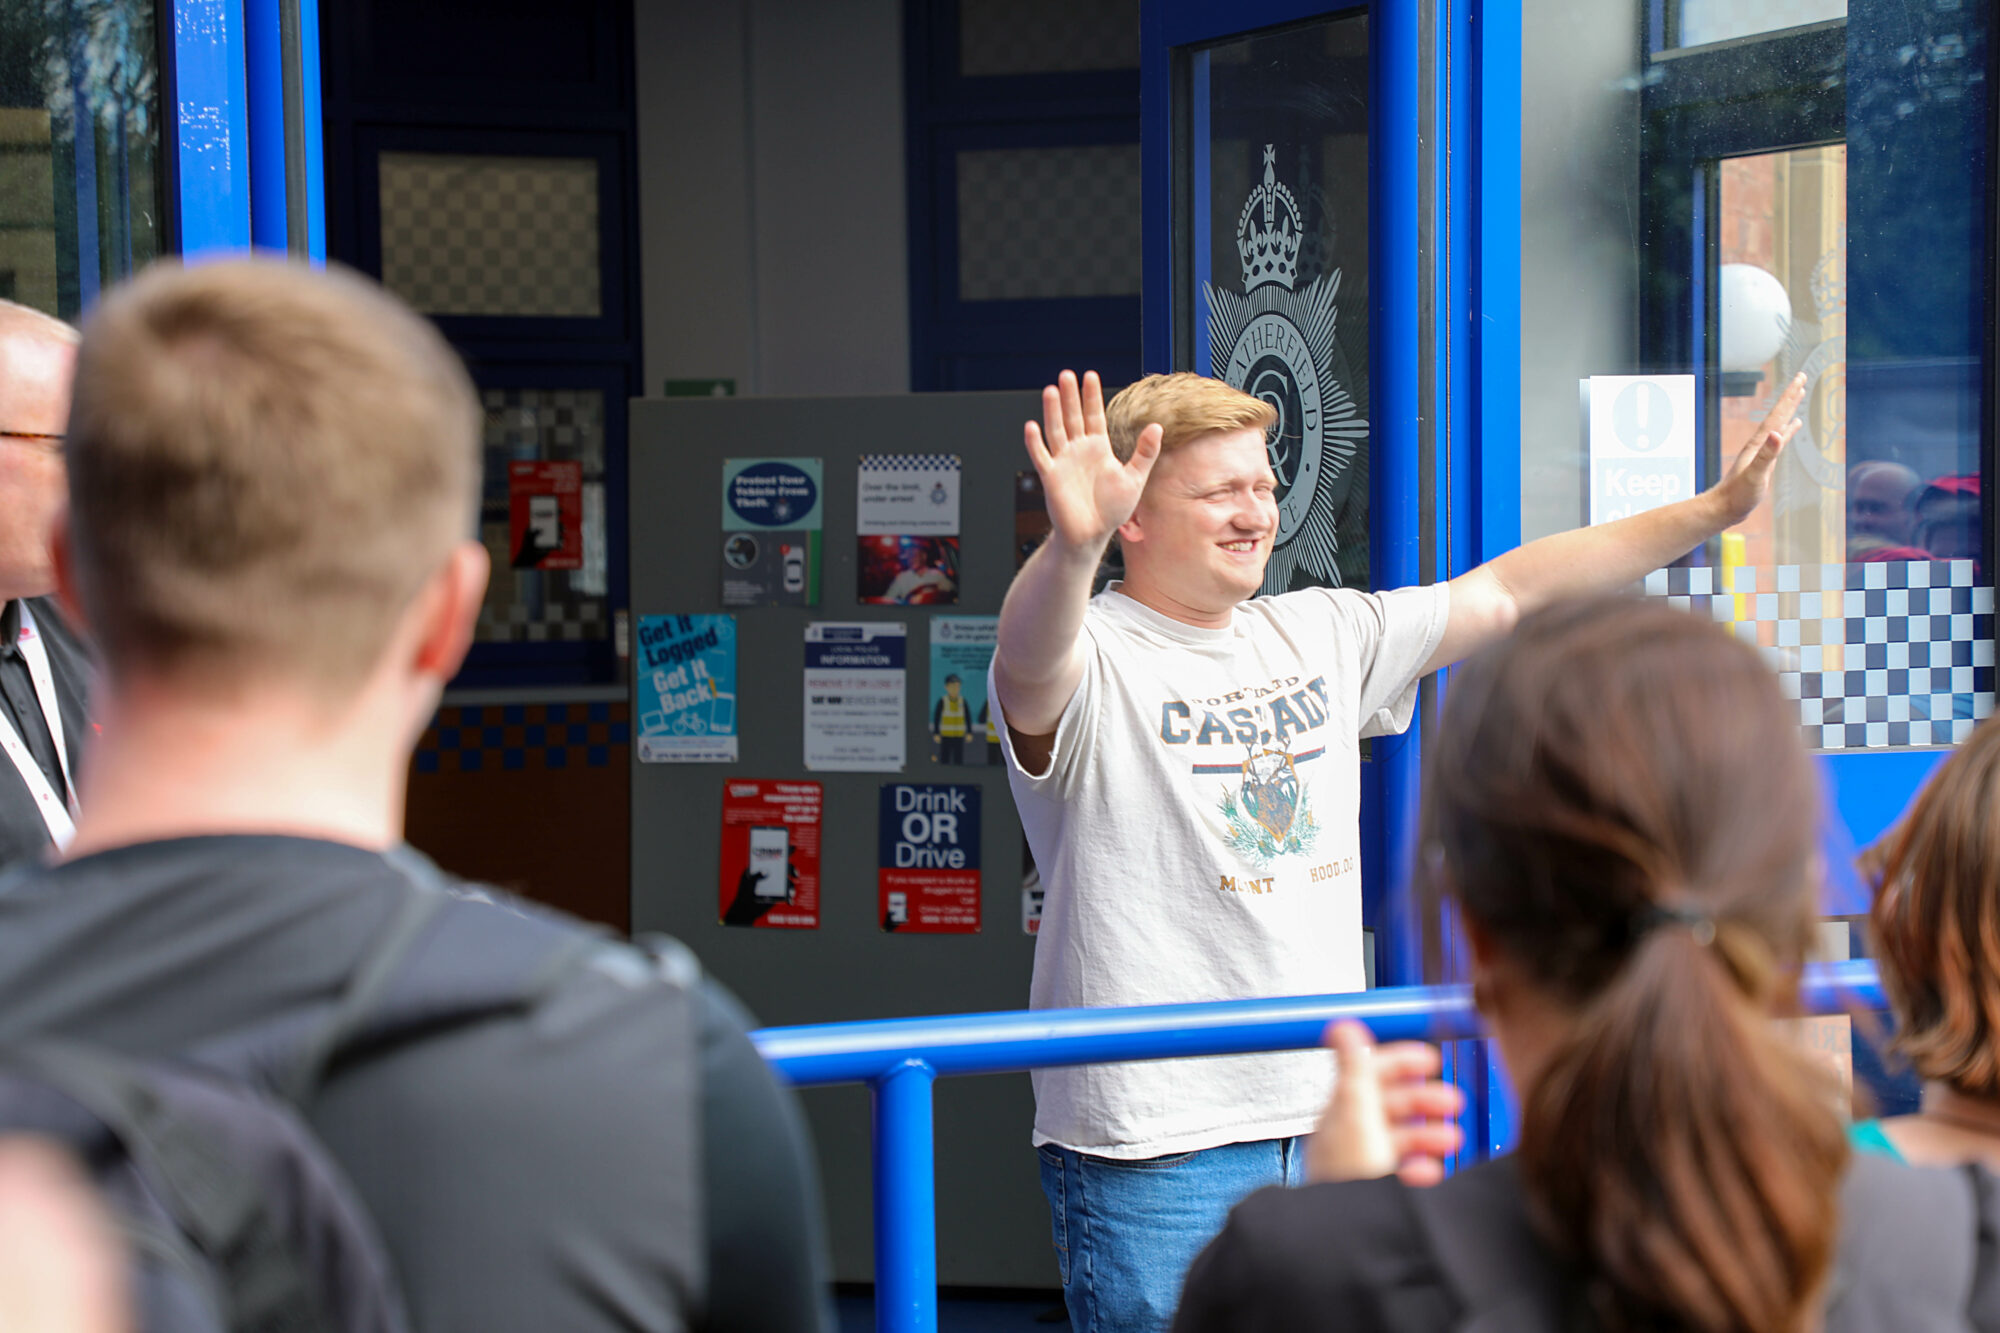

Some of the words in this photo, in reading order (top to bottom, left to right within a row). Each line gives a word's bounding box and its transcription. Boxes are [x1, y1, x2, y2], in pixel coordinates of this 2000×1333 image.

[863, 494, 887, 503] under
[885, 482, 899, 491] the
[1605, 468, 1681, 503] Keep
[639, 620, 673, 647] Get
[645, 626, 718, 667] Logged
[820, 654, 891, 666] INFORMATION
[653, 665, 689, 694] Get
[659, 682, 713, 714] Back
[895, 785, 967, 813] Drink
[901, 812, 959, 845] OR
[895, 841, 966, 869] Drive
[1219, 875, 1275, 894] MNT
